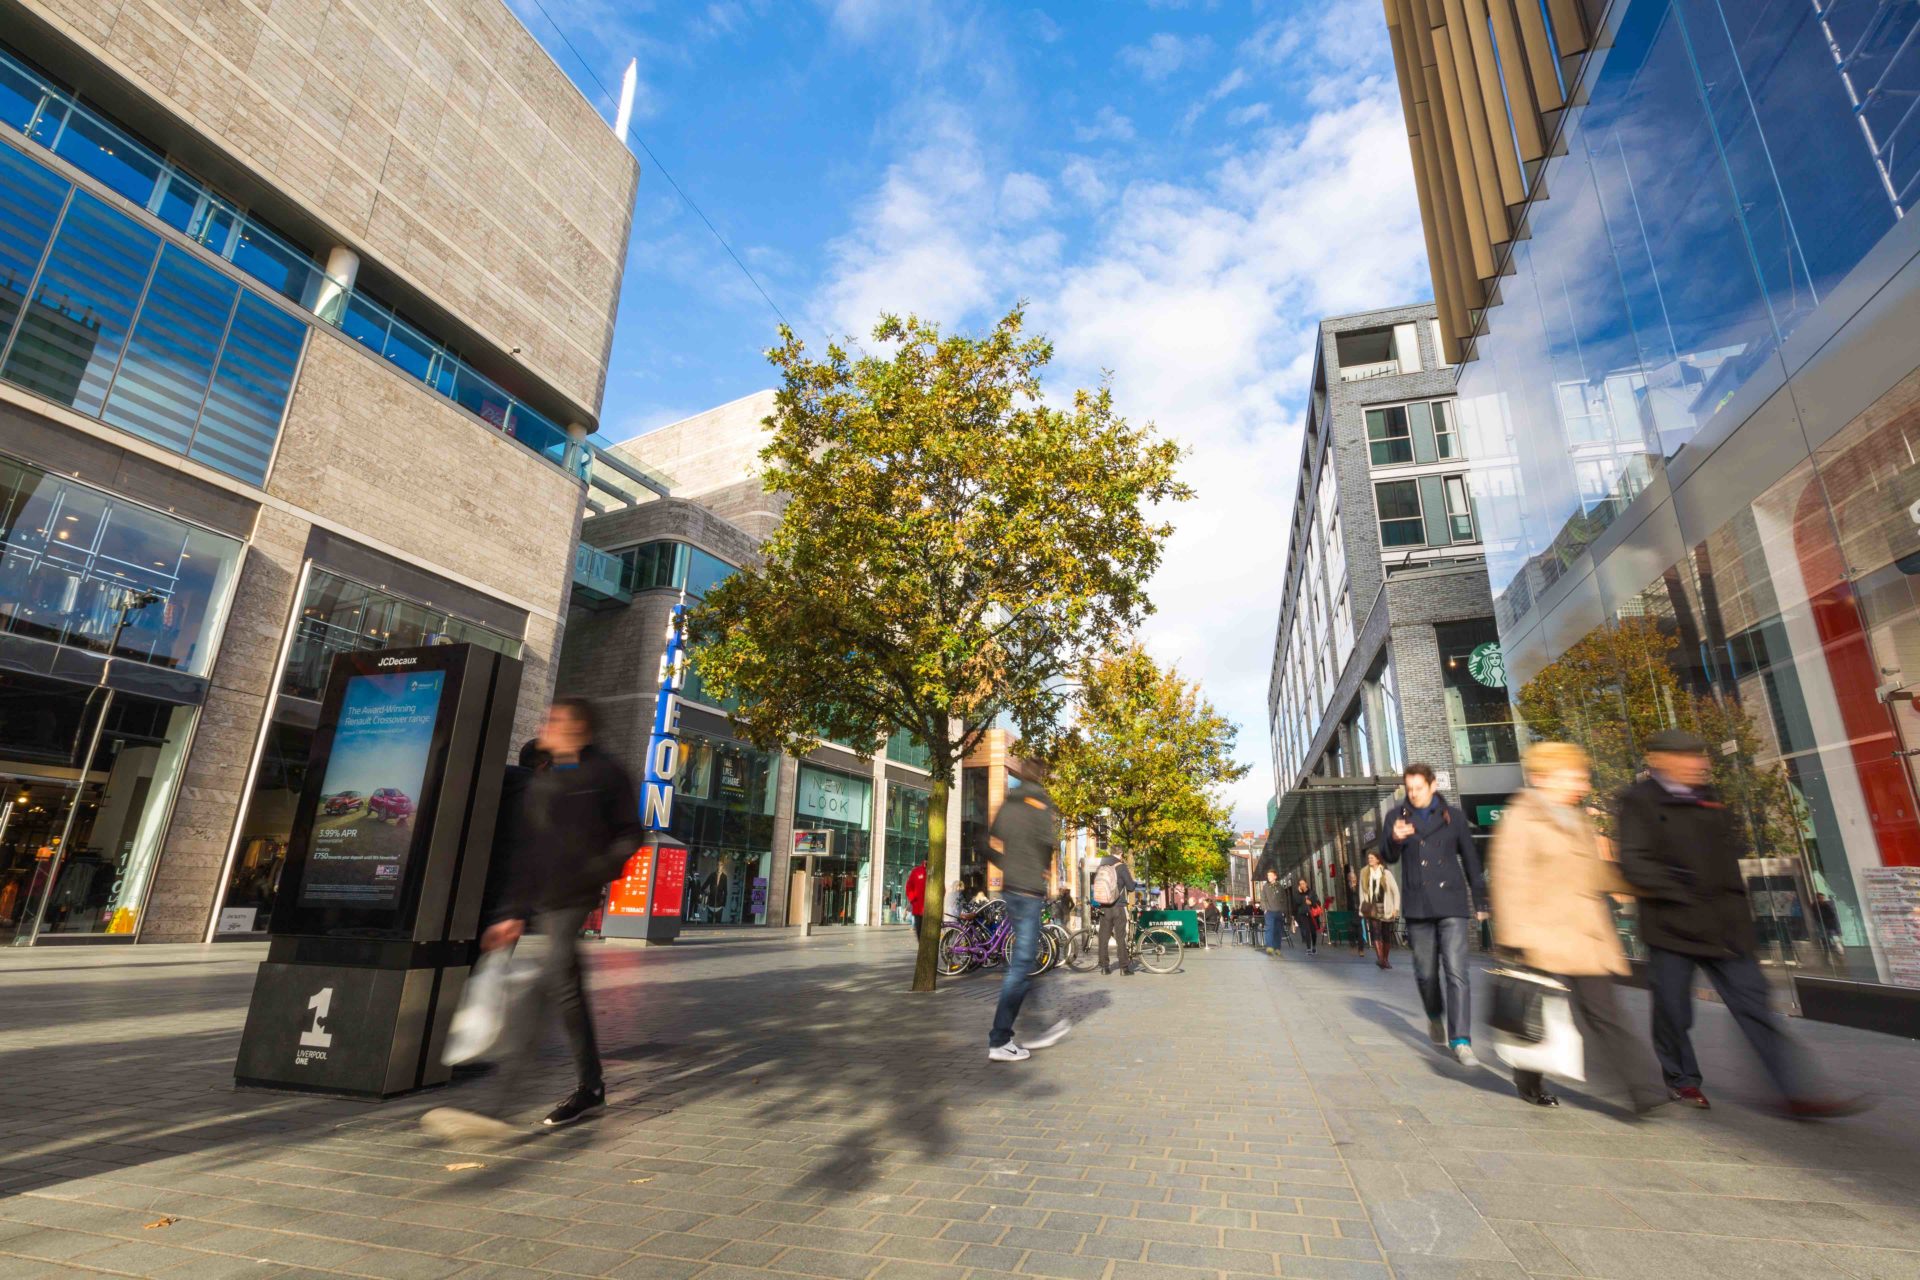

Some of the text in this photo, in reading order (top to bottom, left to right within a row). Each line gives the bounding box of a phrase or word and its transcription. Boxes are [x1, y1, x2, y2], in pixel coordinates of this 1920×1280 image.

[378, 657, 417, 666] JCDecaux
[348, 704, 416, 715] The Award-Winning
[344, 714, 431, 726] Renault Crossover range
[813, 775, 847, 796] NEW
[808, 794, 849, 815] LOOK
[318, 829, 357, 838] 3.99% APR
[297, 1049, 328, 1060] LIVERPOOL
[295, 1057, 309, 1066] ONE
